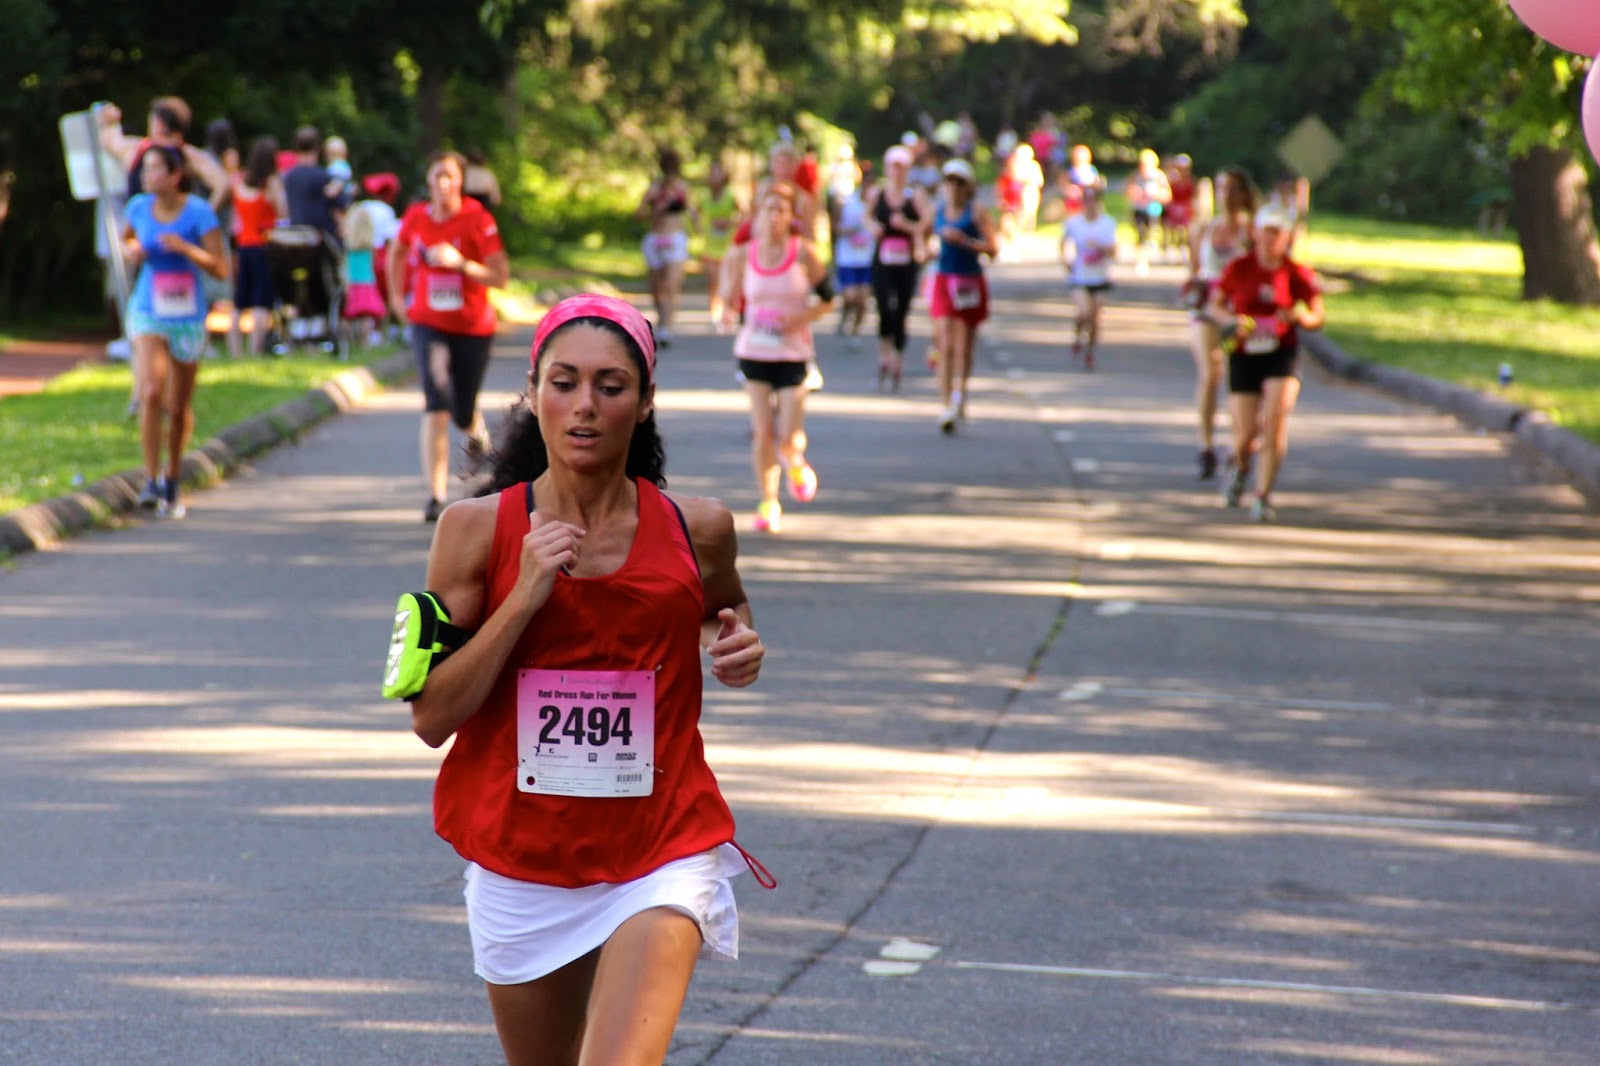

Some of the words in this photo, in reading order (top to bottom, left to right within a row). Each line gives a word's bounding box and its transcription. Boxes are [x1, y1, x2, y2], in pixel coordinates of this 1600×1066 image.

[538, 690, 553, 699] Red
[555, 690, 578, 699] Dress
[580, 691, 595, 700] Run
[596, 692, 610, 700] For
[612, 692, 637, 700] Women
[538, 705, 632, 747] 2494
